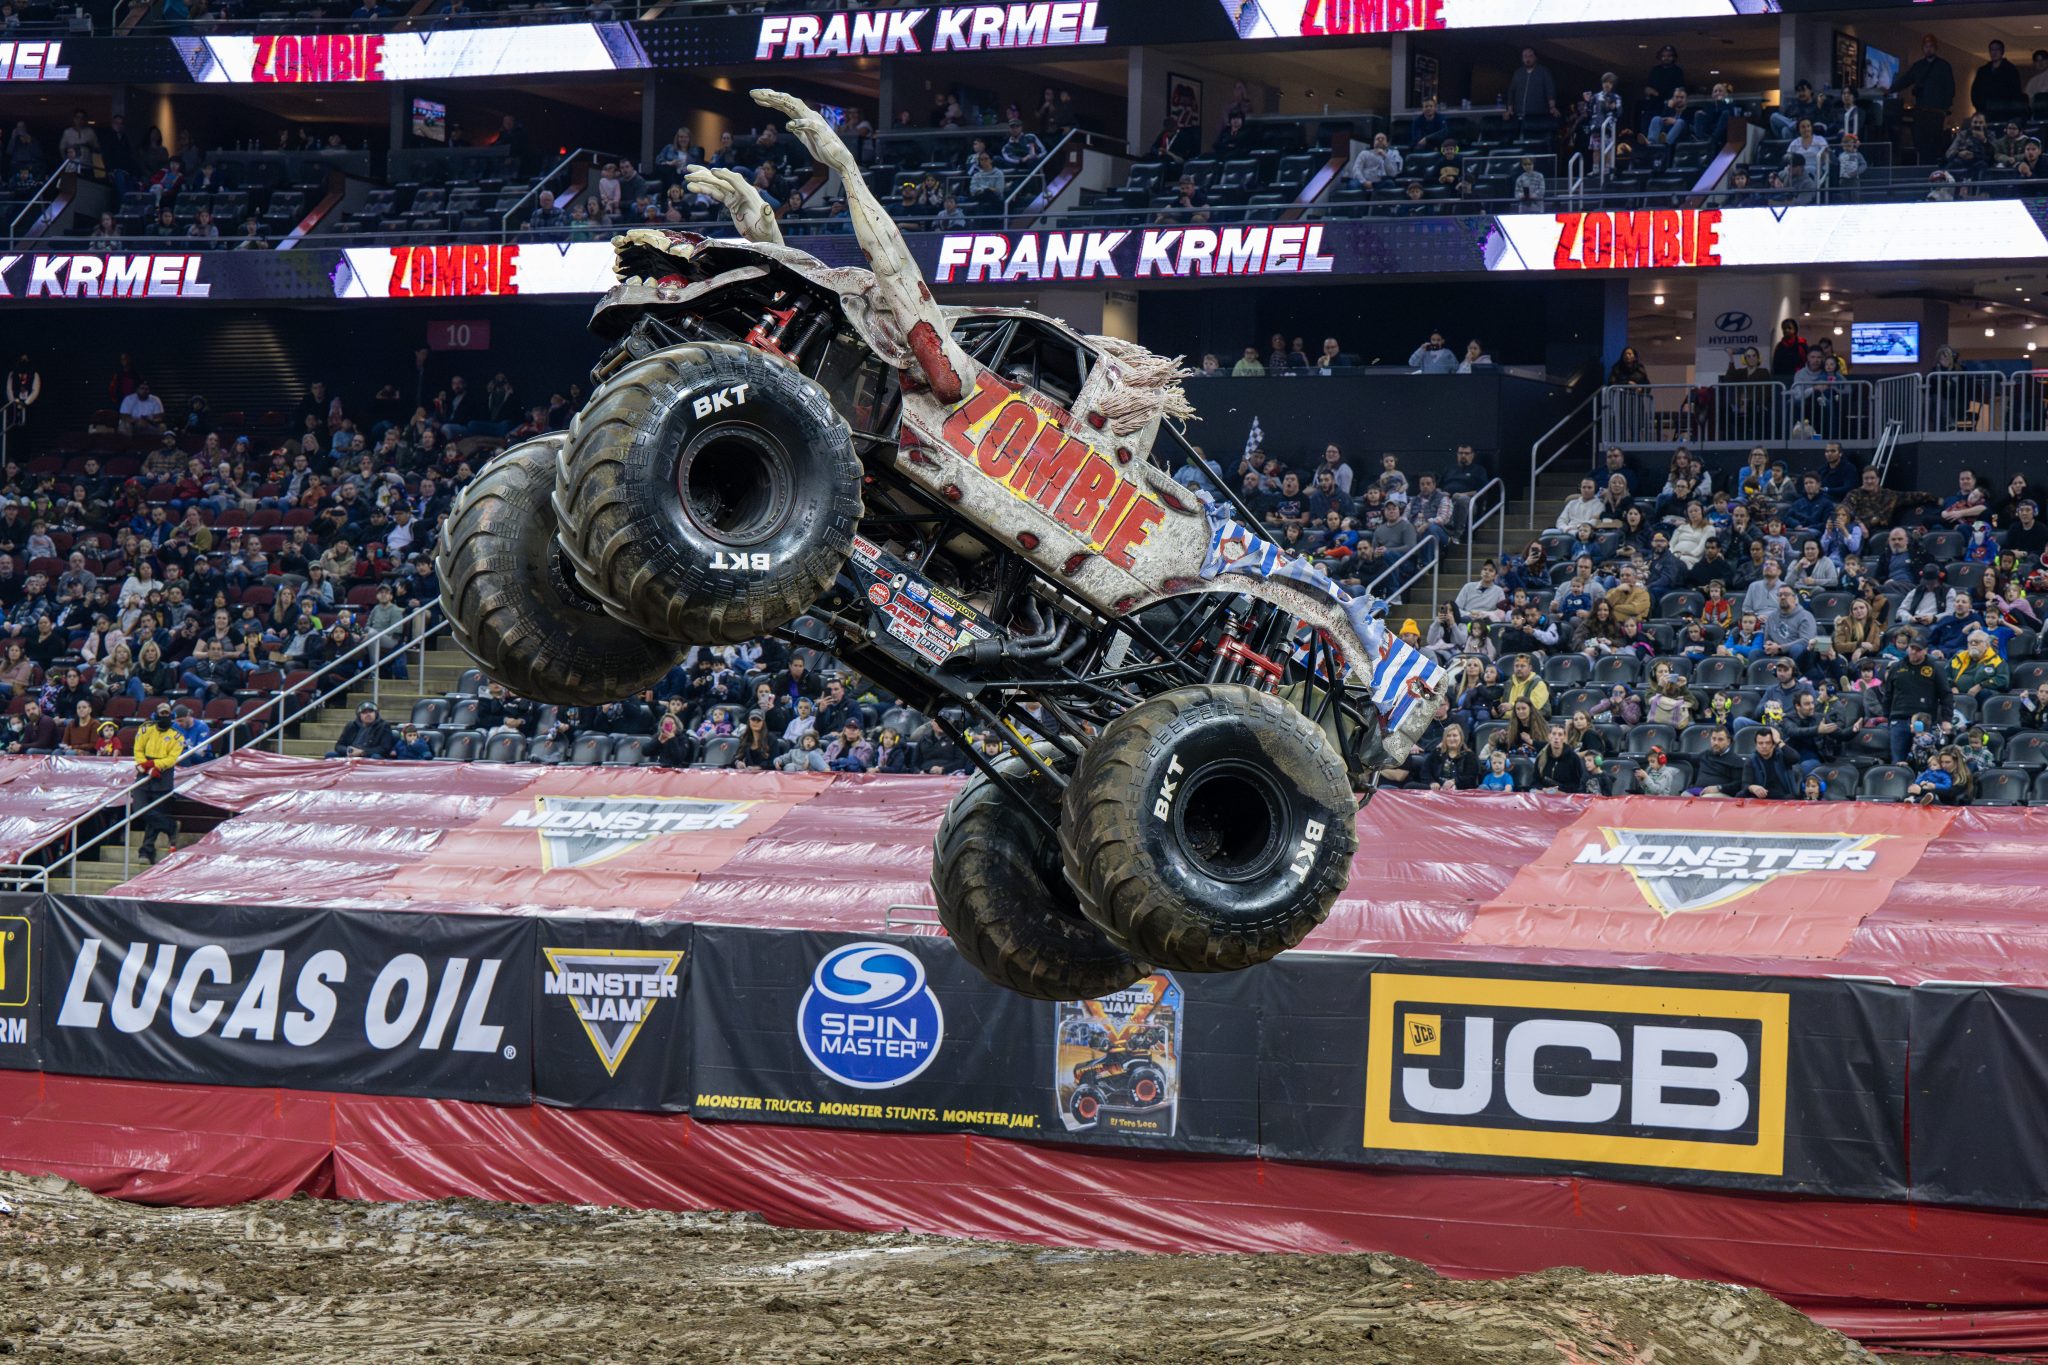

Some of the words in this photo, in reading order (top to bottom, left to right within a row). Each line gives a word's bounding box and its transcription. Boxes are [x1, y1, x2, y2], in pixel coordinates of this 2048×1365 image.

[755, 9, 929, 60] FRANK
[932, 0, 1109, 51] KRMEL
[1300, 0, 1447, 36] ZOMBIE
[251, 34, 385, 82] ZOMBIE
[934, 229, 1132, 282] FRANK
[1135, 224, 1336, 277] KRMEL
[1554, 209, 1722, 270] ZOMBIE
[26, 253, 211, 298] KRMEL
[388, 244, 520, 297] ZOMBIE
[447, 324, 471, 346] 10
[1708, 335, 1758, 345] HYUNDAI
[693, 384, 749, 419] BKT
[943, 369, 1165, 572] ZOMBIE
[709, 552, 771, 570] BKT
[854, 551, 878, 573] Holley
[882, 602, 924, 628] ARP
[932, 587, 976, 619] MAGNAFLOW
[921, 636, 946, 658] OPTIMA
[924, 623, 951, 644] LINCOLN
[1153, 753, 1185, 822] BKT
[501, 809, 750, 830] MONSTER
[1289, 818, 1326, 884] BKT
[1572, 843, 1877, 871] MONSTER
[57, 938, 347, 1046] LUCAS
[544, 971, 678, 998] MONSTER
[1092, 990, 1154, 1004] NSTER
[581, 998, 641, 1022] JAM
[1103, 1001, 1134, 1014] JAM
[820, 1012, 917, 1040] SPIN
[1412, 1023, 1435, 1044] JCB
[1402, 1016, 1749, 1131] JCB
[696, 1094, 762, 1110] MONSTER
[765, 1098, 815, 1113] TRUCKS.
[818, 1101, 883, 1118] MONSTER
[885, 1106, 939, 1121] STUNTS.
[942, 1109, 1008, 1126] MONSTER
[1119, 1118, 1136, 1128] Toro
[1137, 1119, 1158, 1129] Loco
